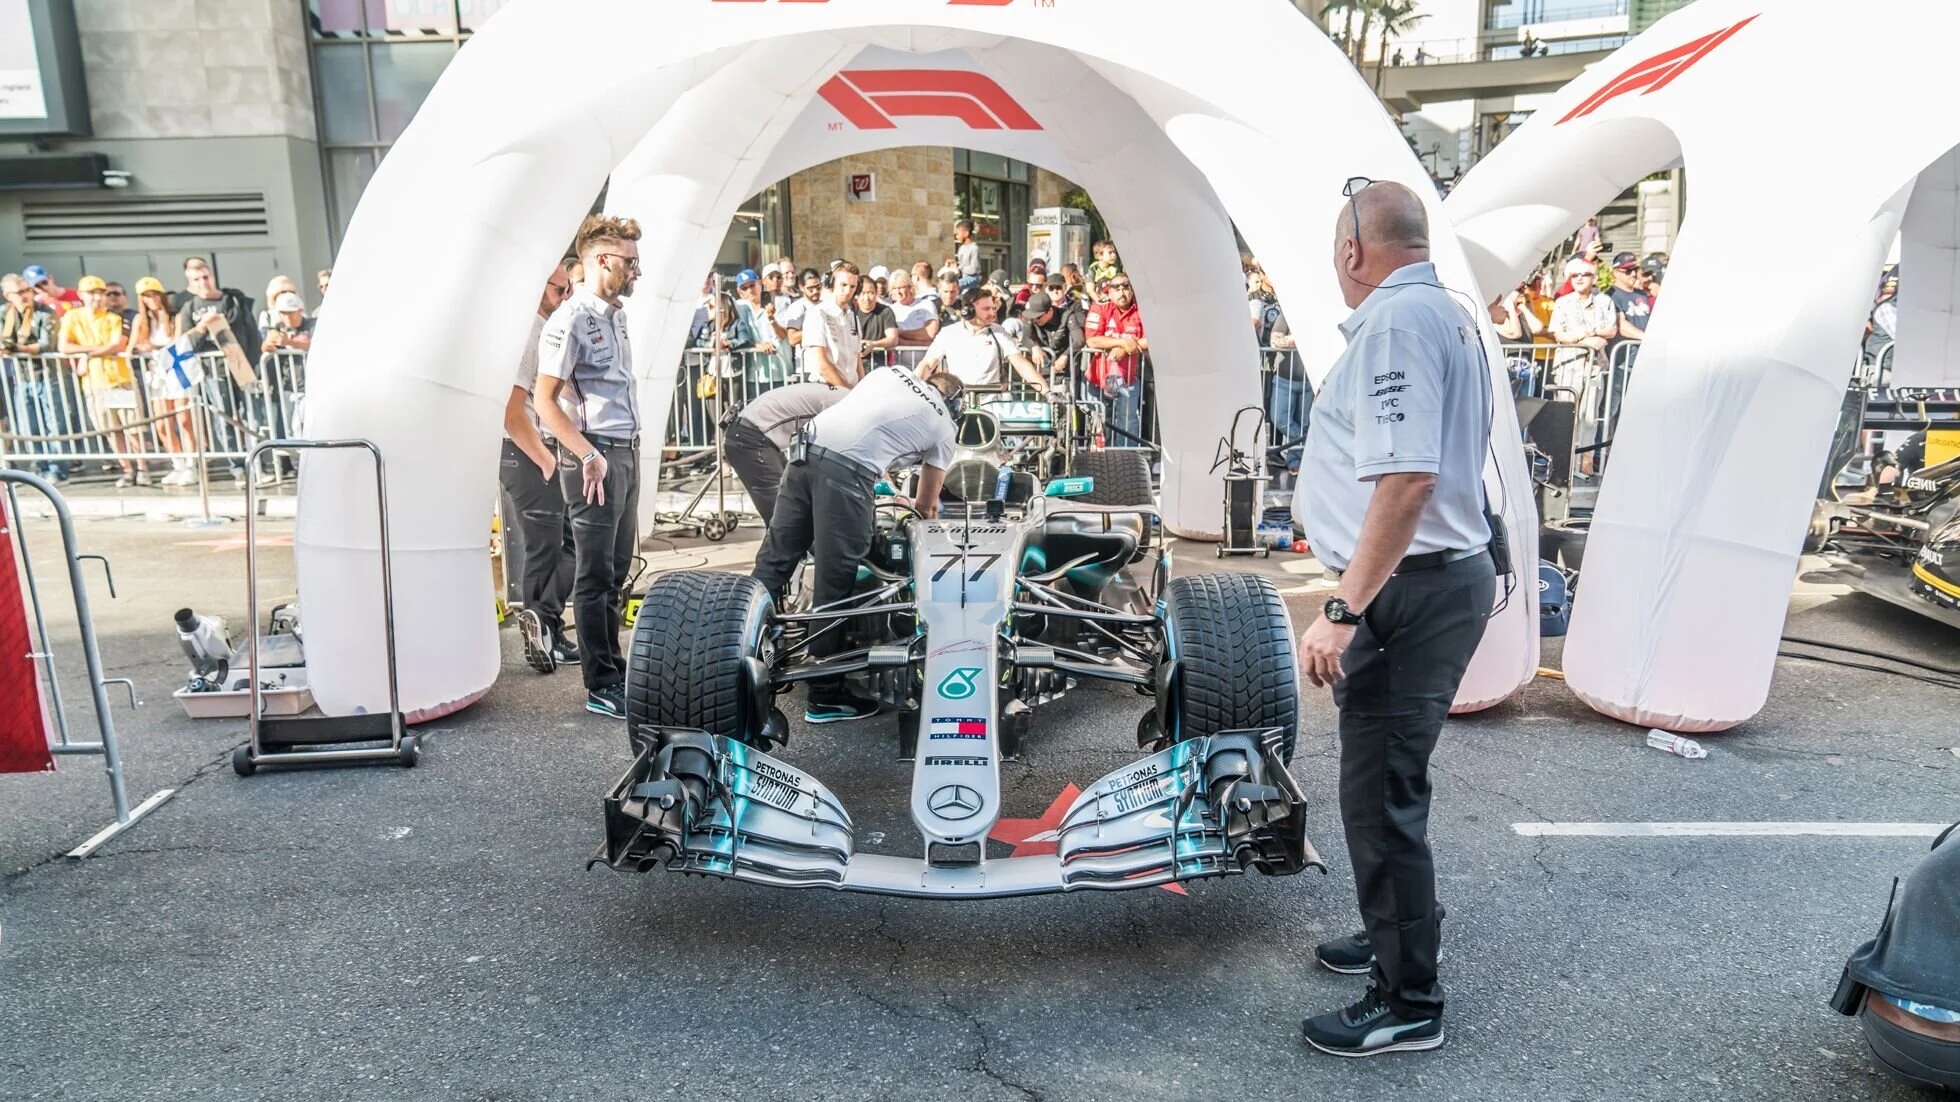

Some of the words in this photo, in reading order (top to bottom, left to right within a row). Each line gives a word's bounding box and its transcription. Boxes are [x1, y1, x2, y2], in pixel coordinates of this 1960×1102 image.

[891, 368, 944, 416] ETRONAS
[930, 554, 1001, 582] 77
[756, 762, 801, 787] PETRONAS
[925, 756, 988, 766] PIRELLI
[1109, 765, 1158, 790] PETRONAS
[751, 776, 800, 810] SYNTIUM
[1114, 778, 1163, 813] SYNTIUM
